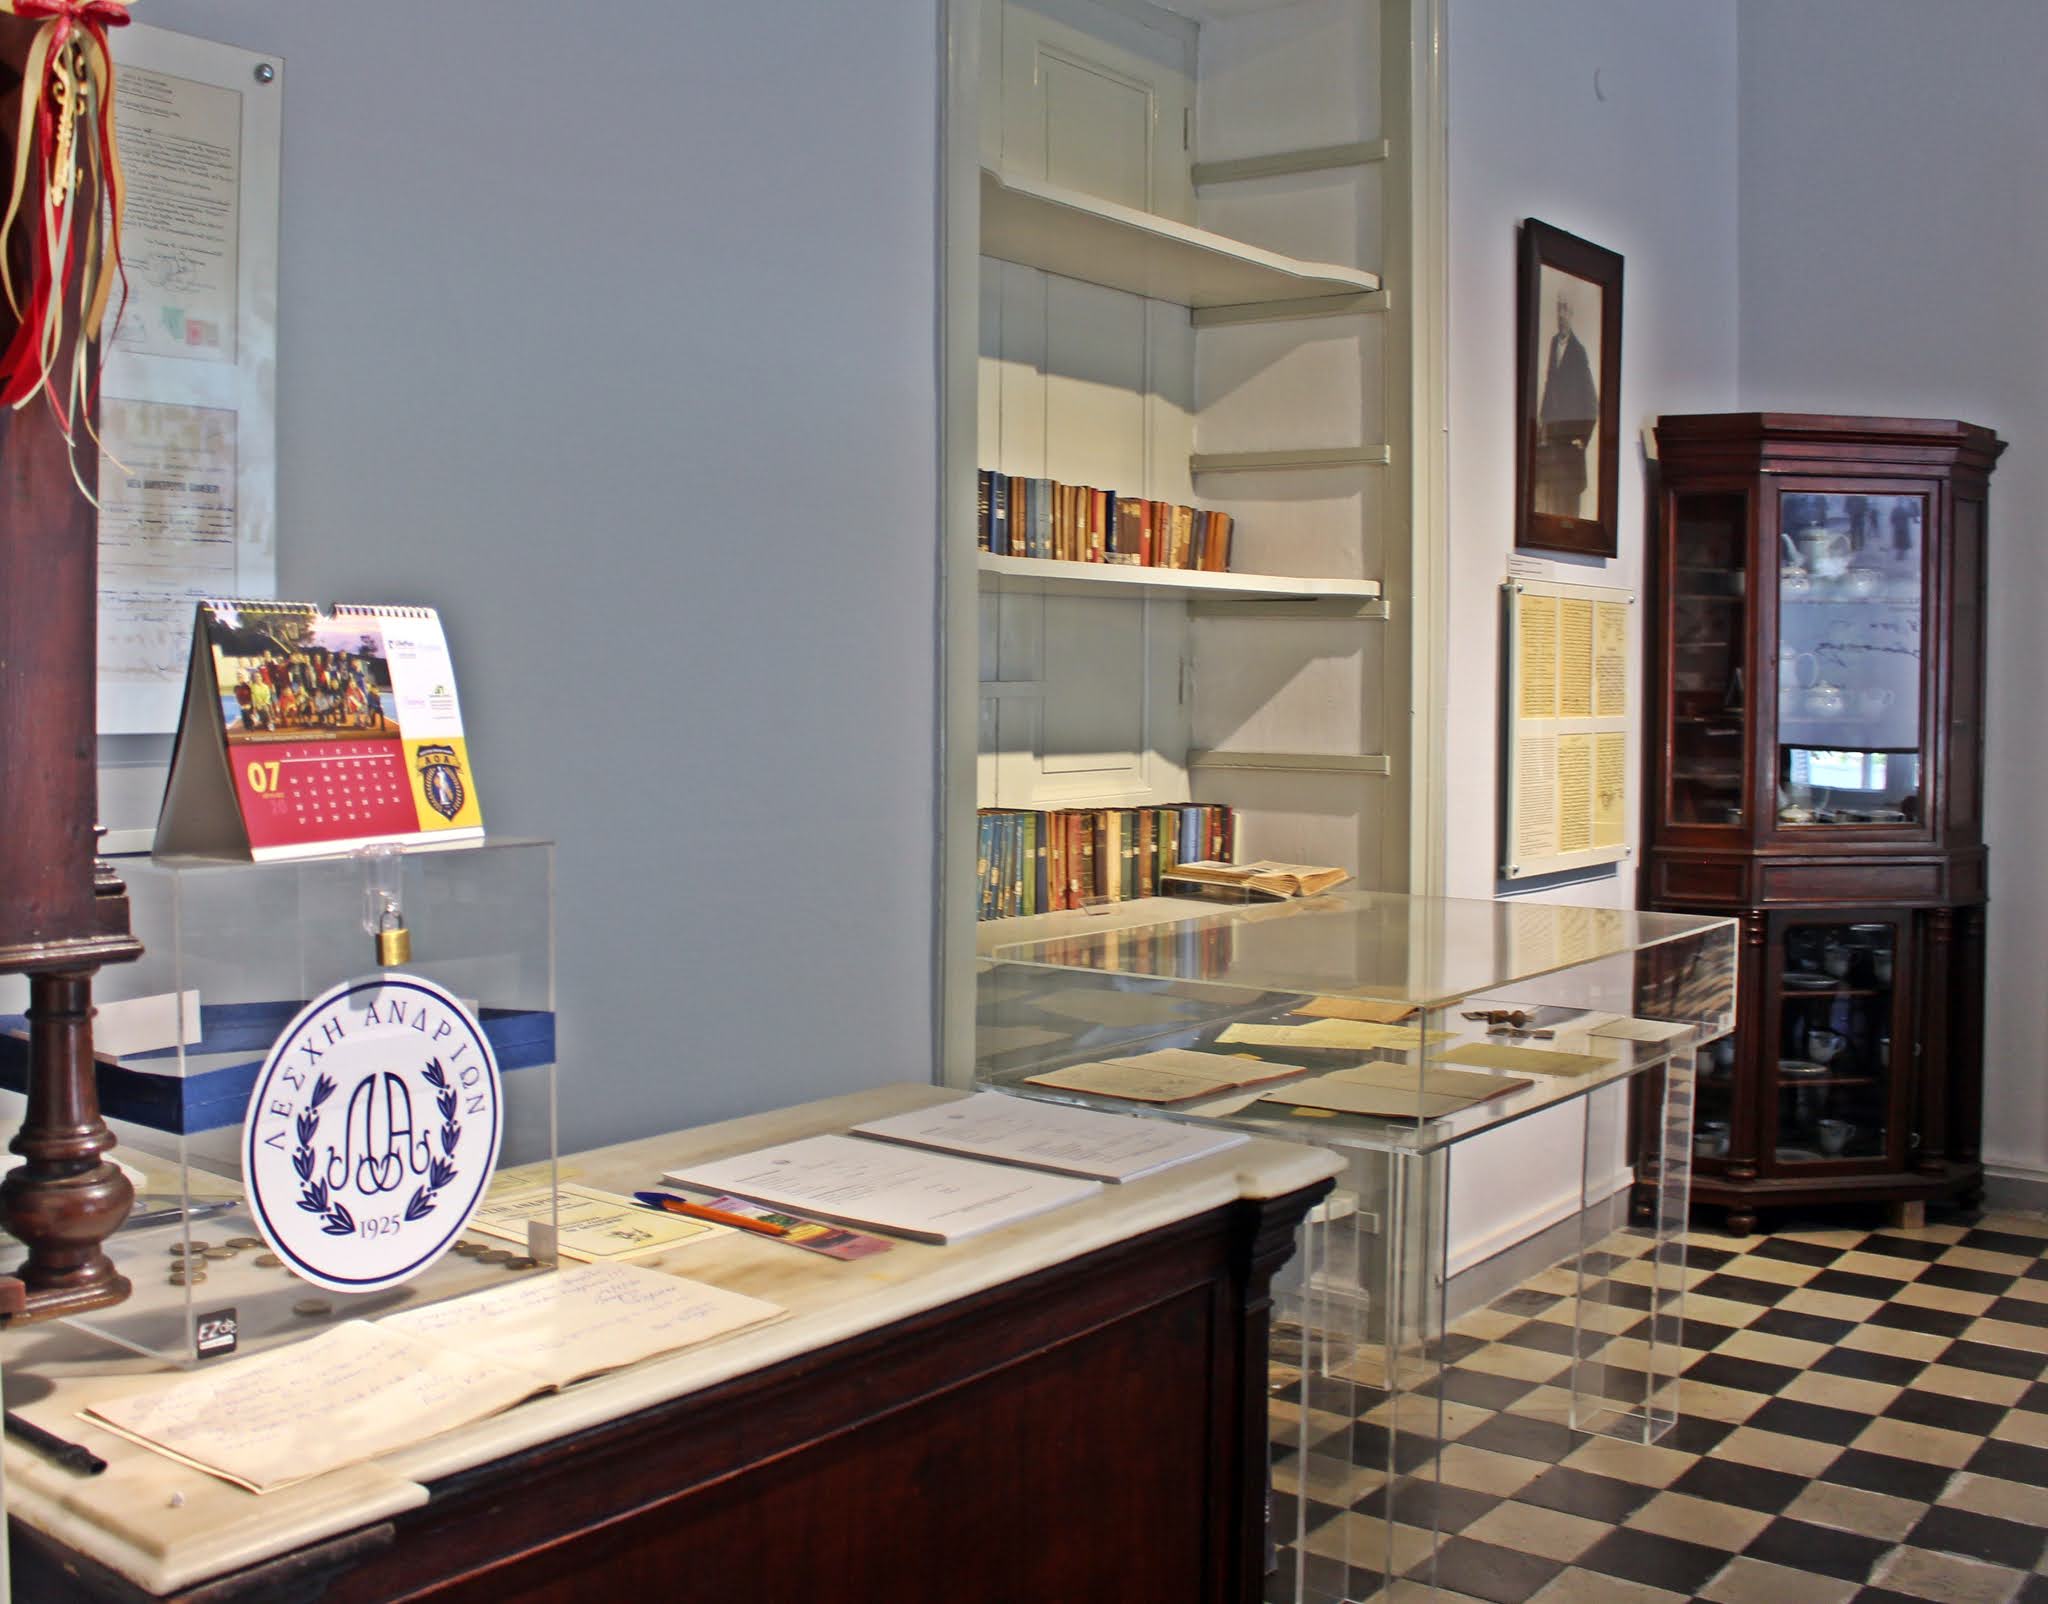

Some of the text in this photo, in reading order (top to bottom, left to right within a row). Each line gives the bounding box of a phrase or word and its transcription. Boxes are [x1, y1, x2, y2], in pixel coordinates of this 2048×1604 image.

[247, 761, 280, 793] 07
[264, 1000, 485, 1150] ΛΕΣΧΗ ΑΝΔΡΙΩΝ
[360, 1214, 401, 1239] 1925
